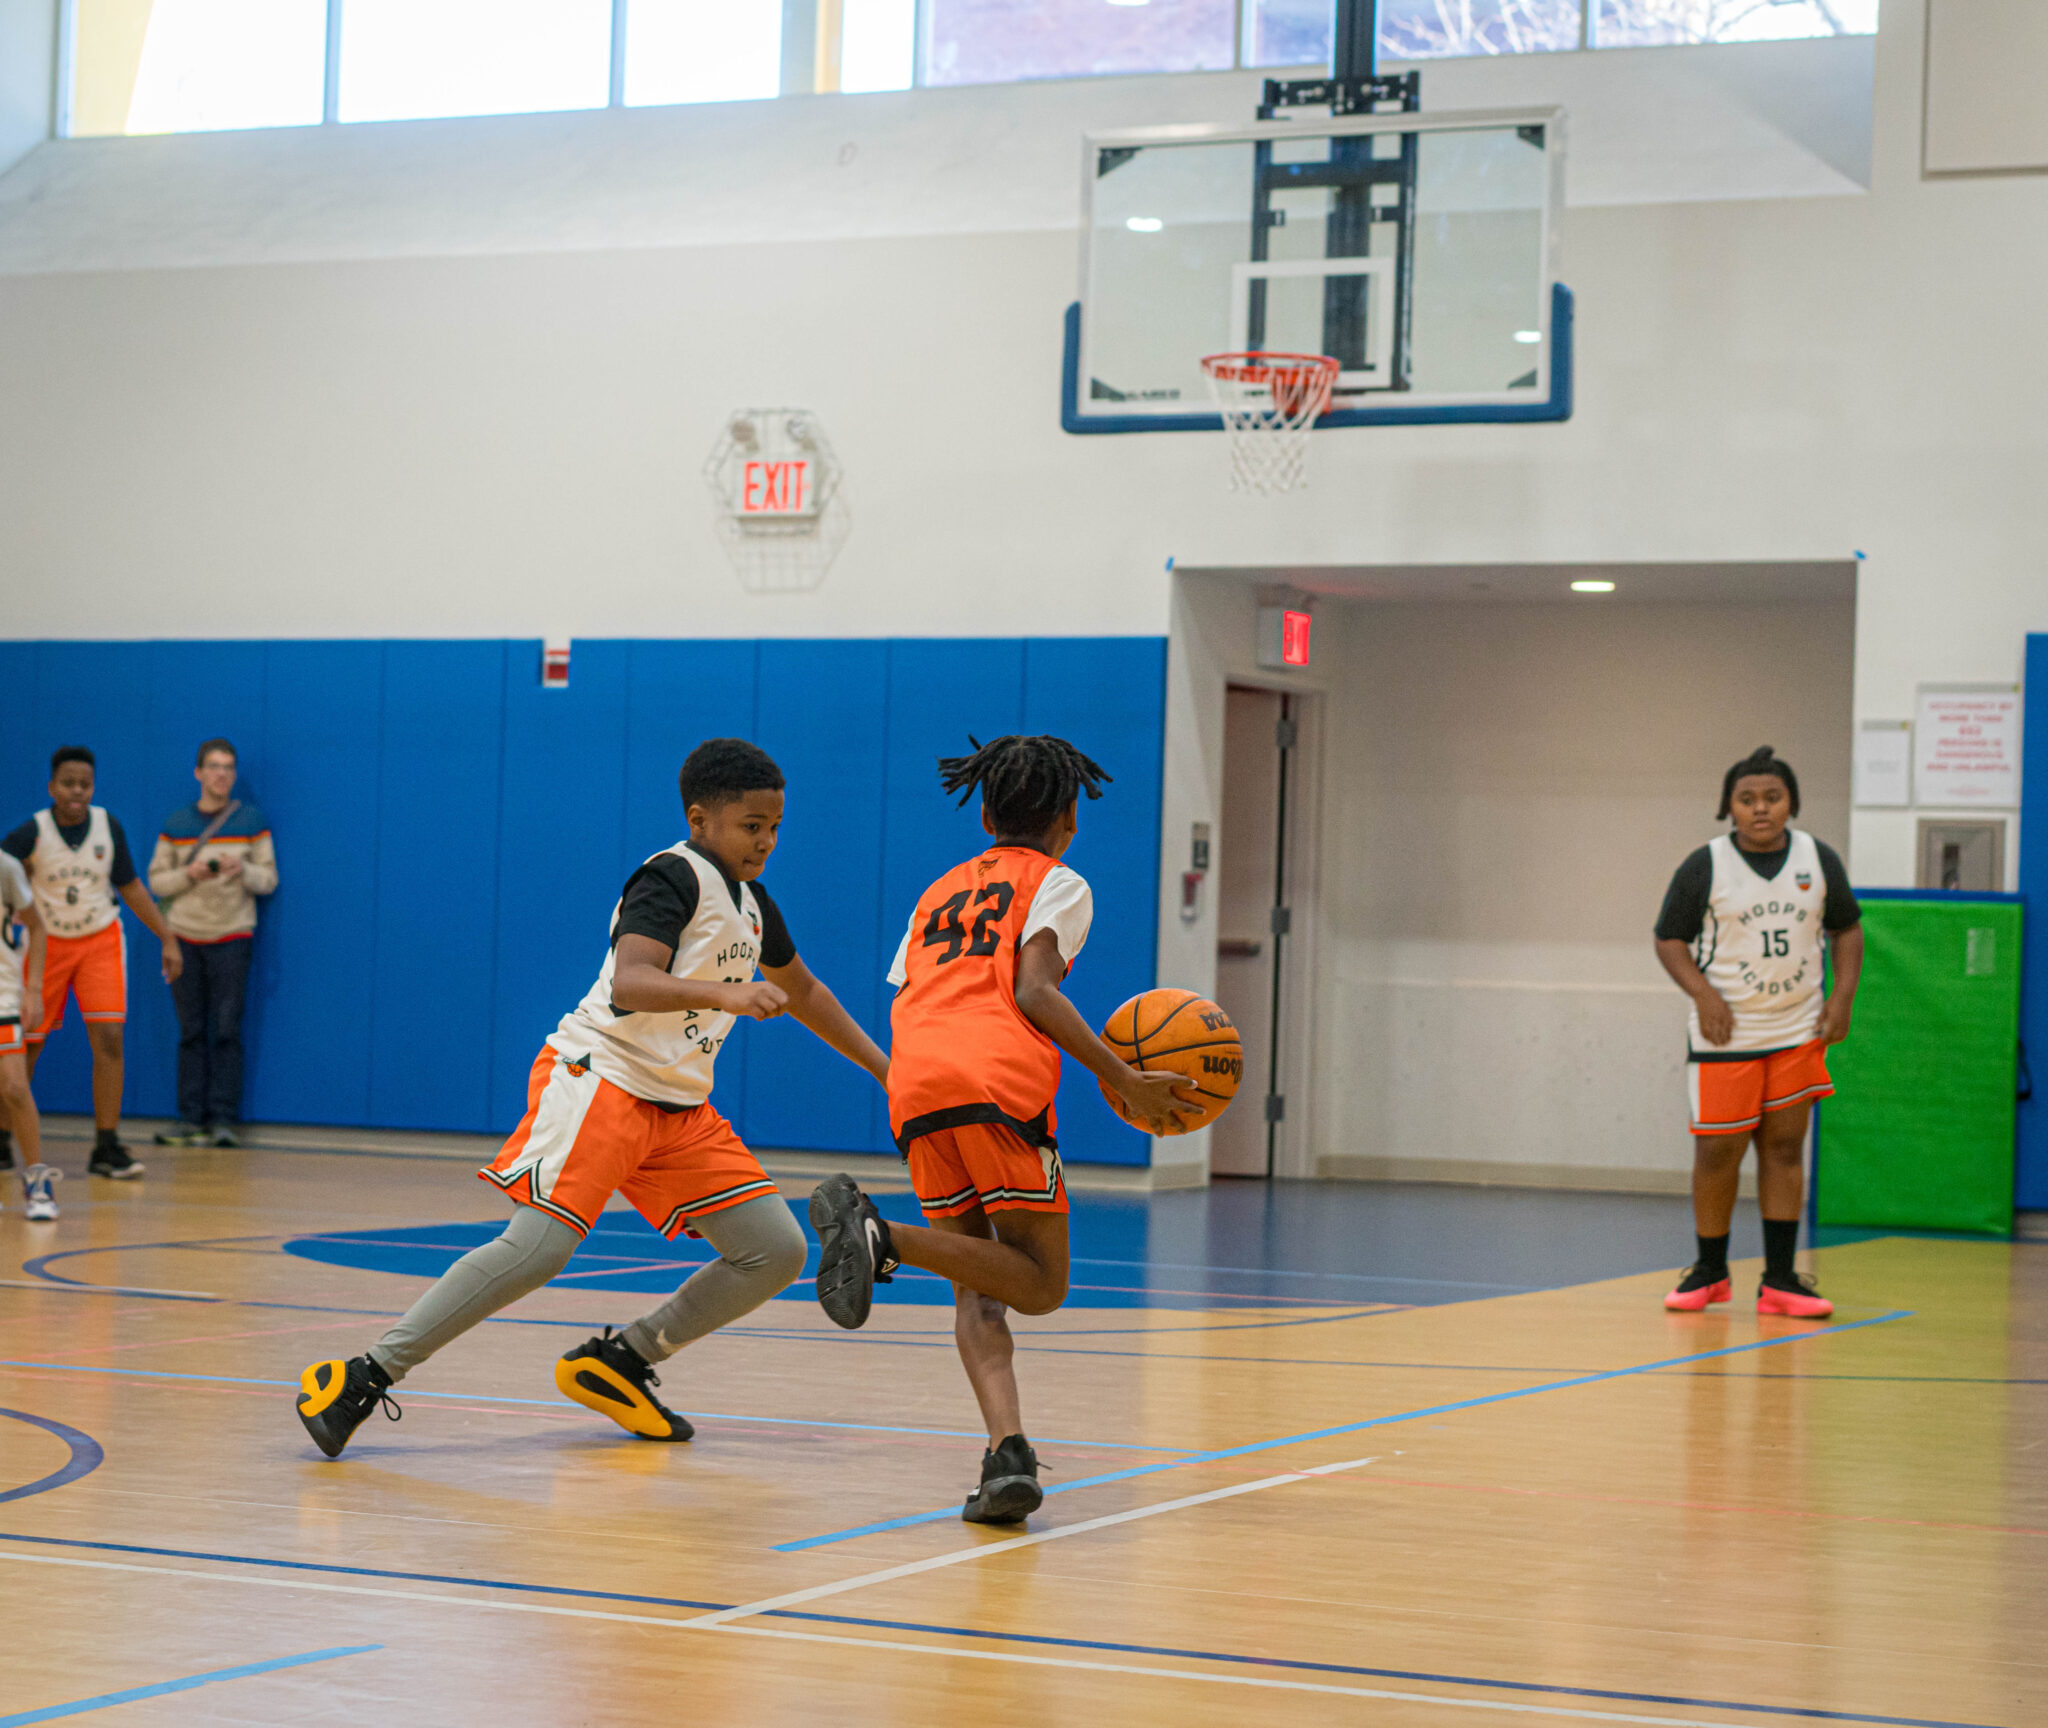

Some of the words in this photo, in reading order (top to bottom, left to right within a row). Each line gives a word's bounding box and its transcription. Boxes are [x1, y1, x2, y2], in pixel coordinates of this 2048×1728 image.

[743, 461, 808, 512] EXIT
[66, 885, 79, 905] 6
[922, 881, 1015, 966] 42
[1738, 901, 1808, 926] HOOPS
[1761, 928, 1789, 958] 15
[1739, 956, 1808, 995] ACADEMY
